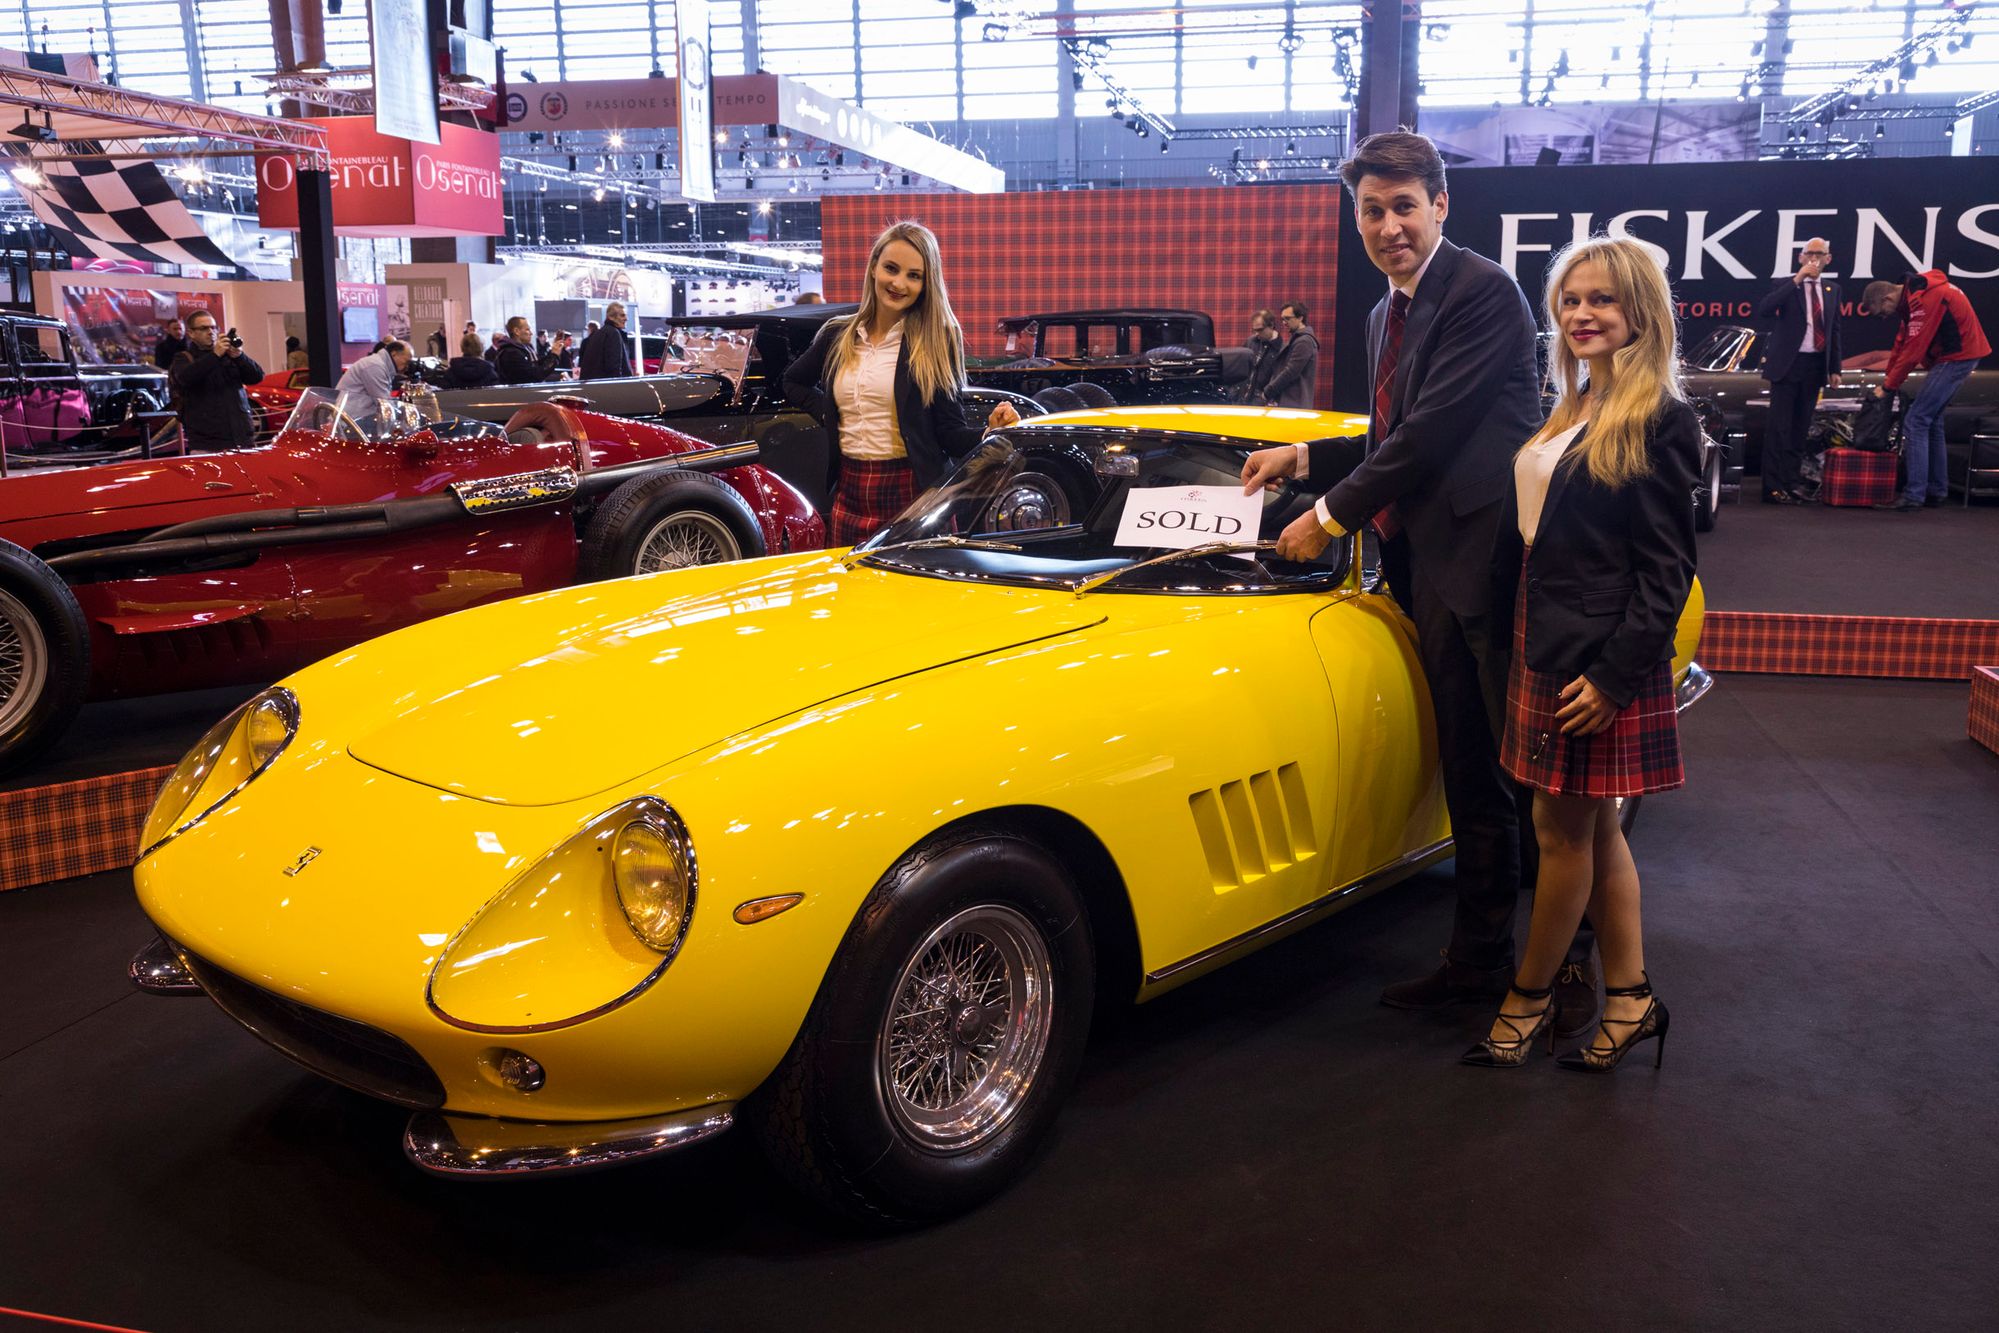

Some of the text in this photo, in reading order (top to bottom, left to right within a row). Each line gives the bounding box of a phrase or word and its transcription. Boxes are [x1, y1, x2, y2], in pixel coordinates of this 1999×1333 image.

[585, 97, 656, 110] PASSIONE
[716, 94, 766, 105] TEMPO
[328, 156, 389, 165] NTAINEBLEAU
[262, 155, 406, 191] Oenat
[416, 154, 500, 200] Osenat
[336, 287, 380, 306] senat
[1677, 302, 1752, 318] TORIC
[1136, 510, 1242, 536] SOLD
